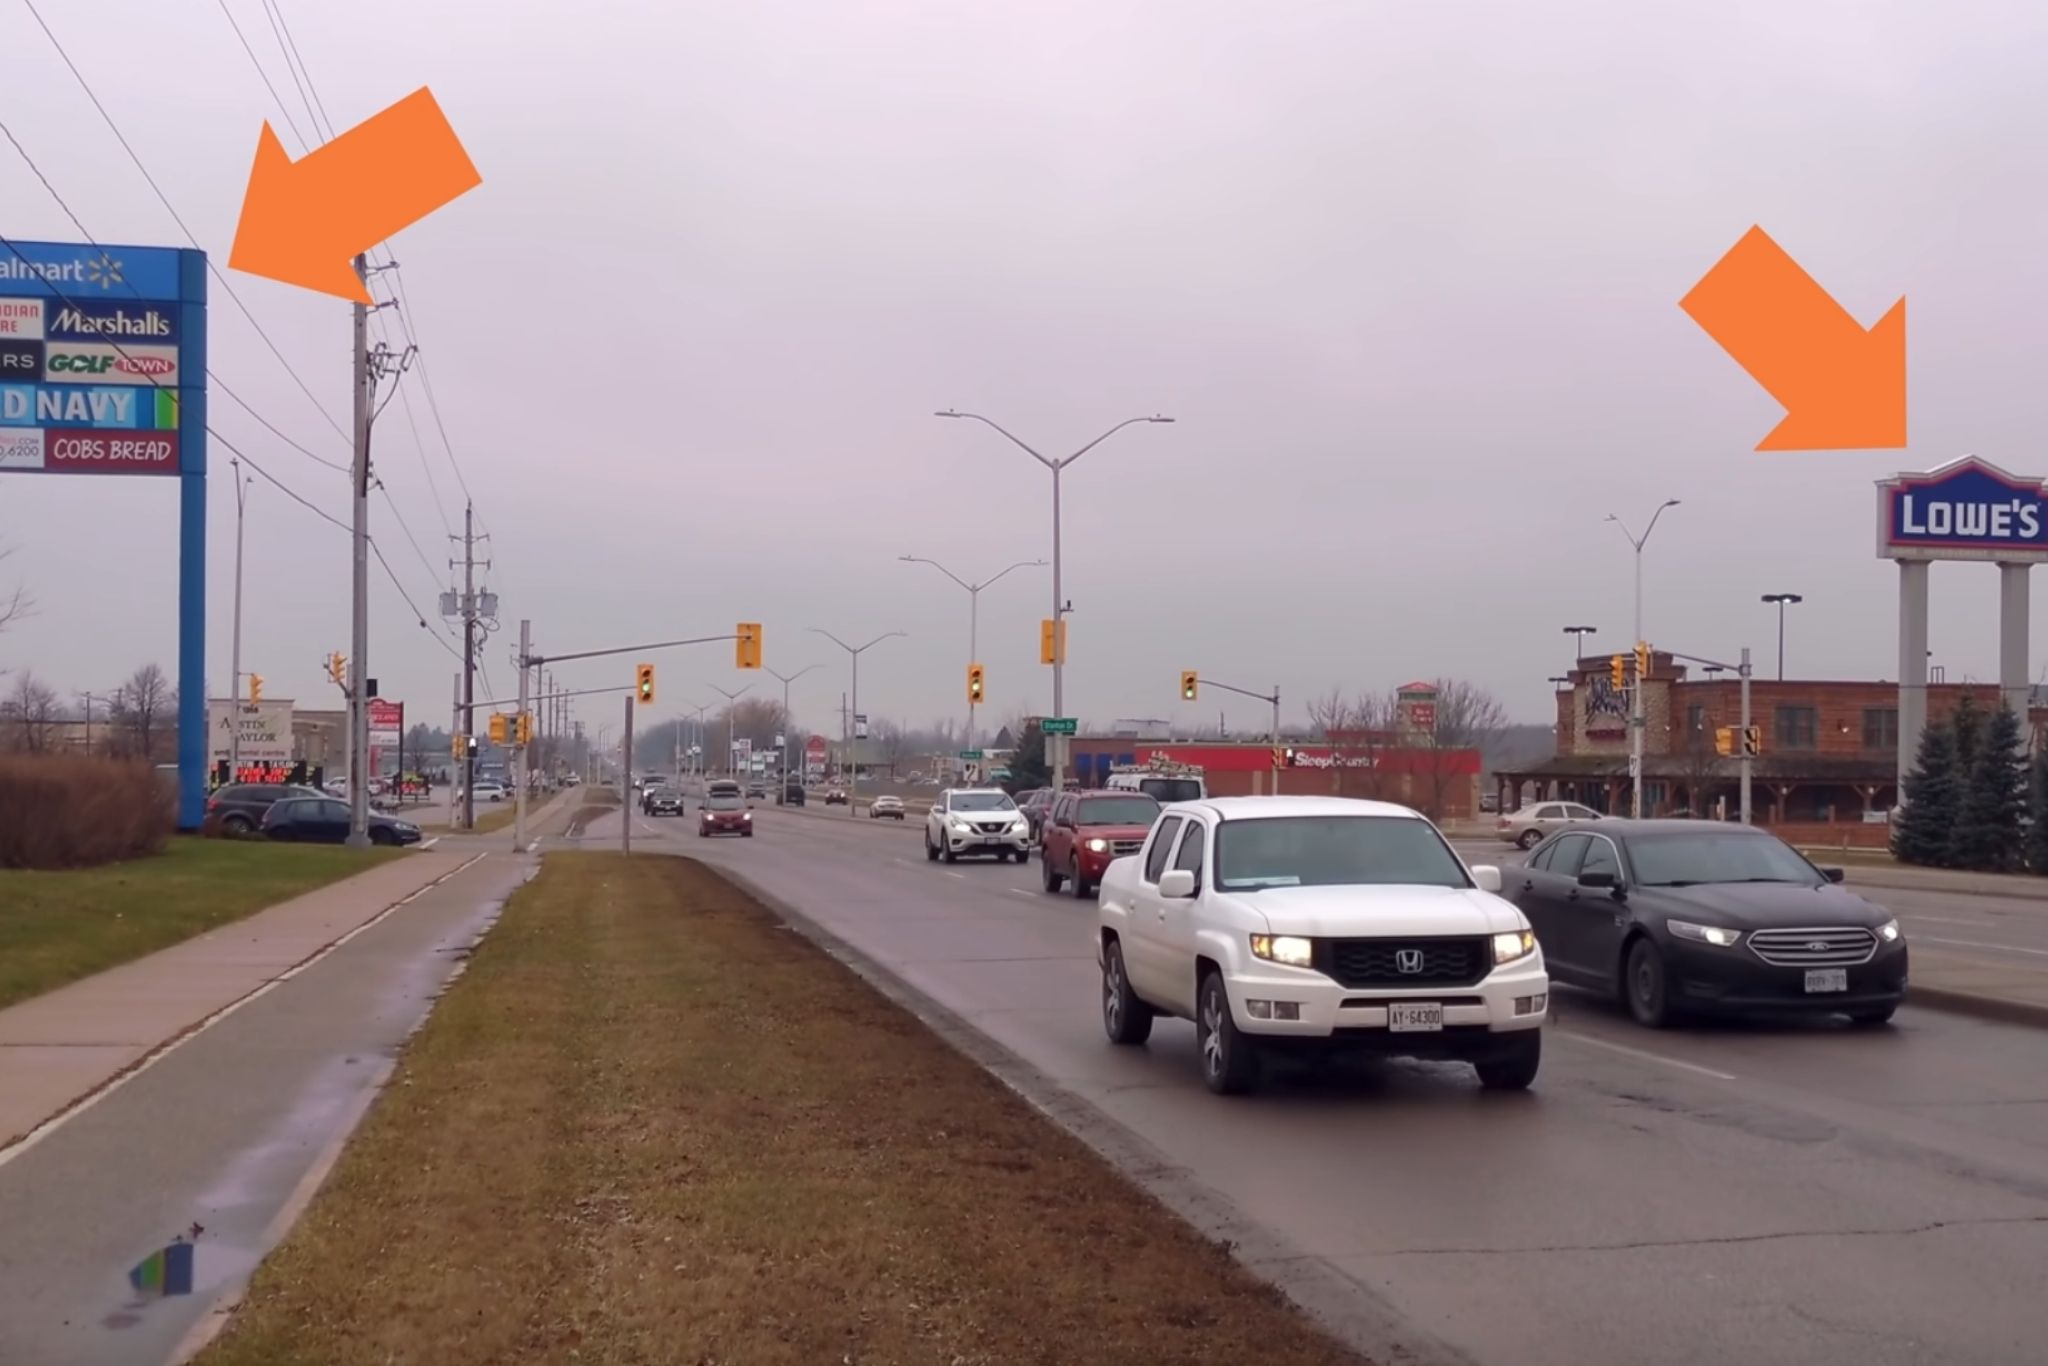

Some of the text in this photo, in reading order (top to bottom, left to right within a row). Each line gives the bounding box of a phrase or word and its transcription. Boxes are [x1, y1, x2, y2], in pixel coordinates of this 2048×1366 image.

[0, 304, 38, 319] DIAN
[50, 308, 170, 336] Marshalls
[48, 354, 114, 374] GOLF
[122, 359, 169, 372] TOWN
[36, 390, 131, 421] NAVY
[54, 438, 171, 461] COBS BREAD
[1903, 495, 2040, 538] LOWE'S
[220, 717, 266, 729] ASTIN
[229, 728, 277, 742] AYLOR
